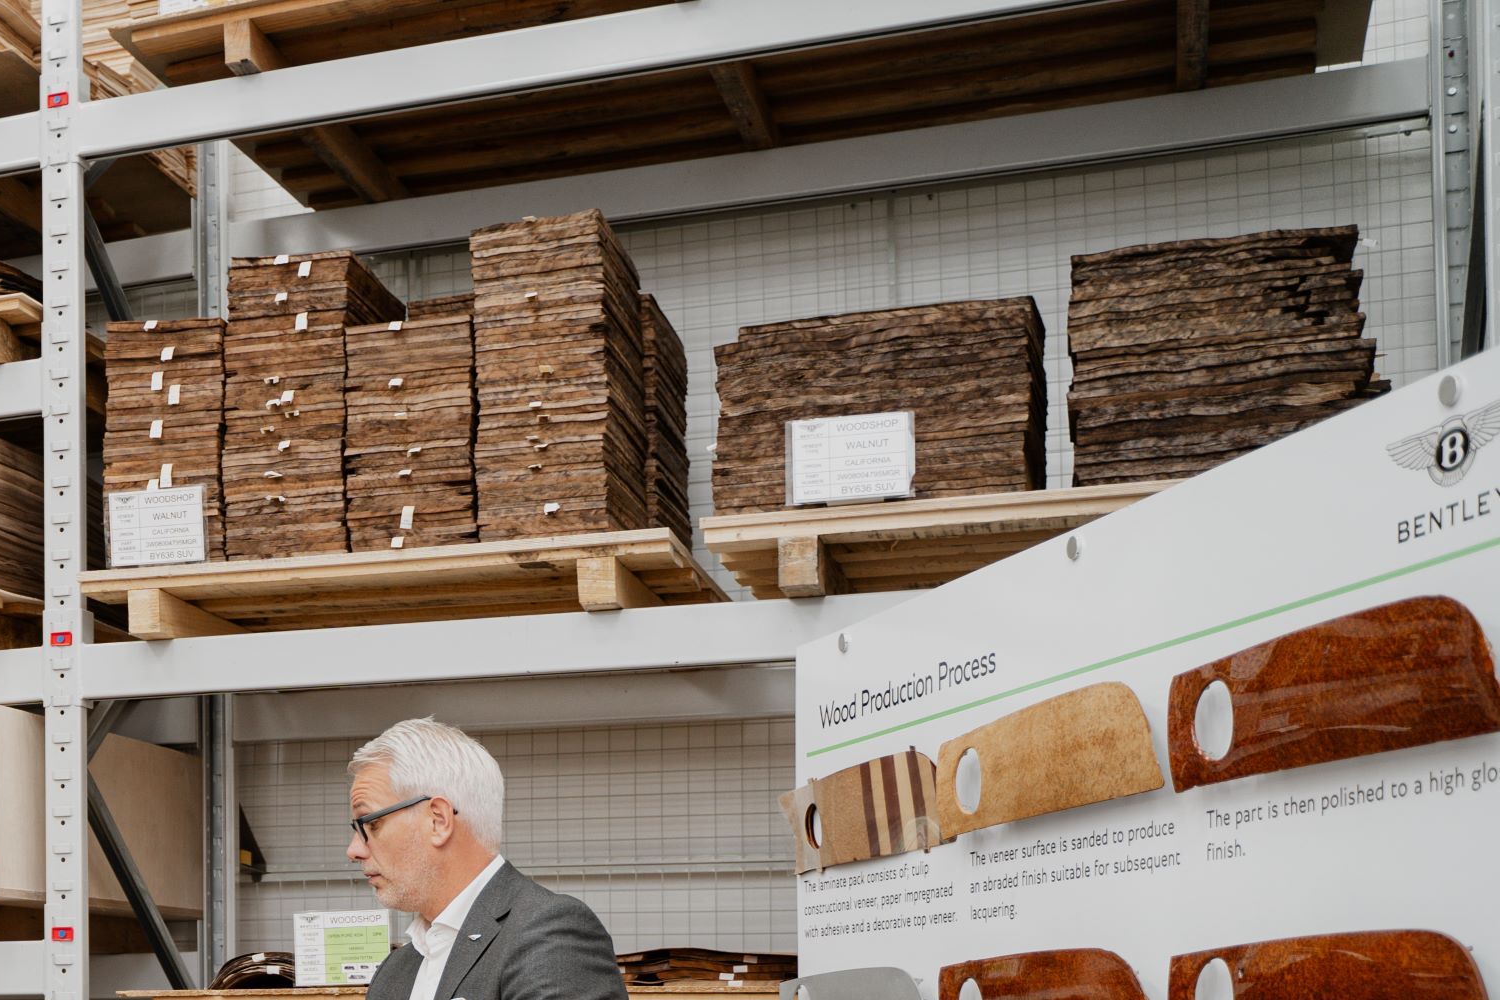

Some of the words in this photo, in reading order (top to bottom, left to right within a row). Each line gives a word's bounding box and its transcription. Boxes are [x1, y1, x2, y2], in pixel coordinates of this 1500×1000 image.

[836, 419, 898, 432] WOODSHOP
[846, 439, 888, 449] WALNUT
[845, 457, 891, 466] CALIFORNIA
[841, 484, 872, 494] BY636
[875, 482, 896, 491] SUV
[145, 493, 194, 504] WOODSHOP
[153, 511, 187, 520] WALNUT
[150, 551, 174, 560] BY636
[177, 550, 194, 558] SUV
[819, 693, 857, 729] Wood
[862, 673, 933, 716] Production
[939, 652, 996, 691] Process
[1207, 810, 1230, 829] The
[1236, 805, 1263, 829] part
[1268, 801, 1278, 819] is
[1284, 797, 1315, 815] then
[1321, 780, 1384, 816] polished
[1391, 782, 1407, 798] to
[1414, 779, 1422, 794] a
[1430, 768, 1464, 795] high
[1472, 762, 1500, 791] glo
[970, 851, 986, 867] The
[989, 848, 1018, 864] veneer
[1022, 840, 1056, 858] surface
[1060, 837, 1067, 852] is
[1071, 829, 1108, 850] sanded
[1112, 831, 1124, 844] to
[1128, 821, 1175, 846] produce
[1207, 840, 1246, 861] finish.
[970, 882, 980, 894] an
[983, 872, 1018, 891] abraded
[1022, 868, 1048, 887] finish
[1051, 862, 1090, 882] suitable
[1095, 860, 1110, 876] for
[1114, 852, 1180, 874] subsequent
[971, 902, 1018, 923] lacquering.
[331, 915, 381, 924] WOODSHOP
